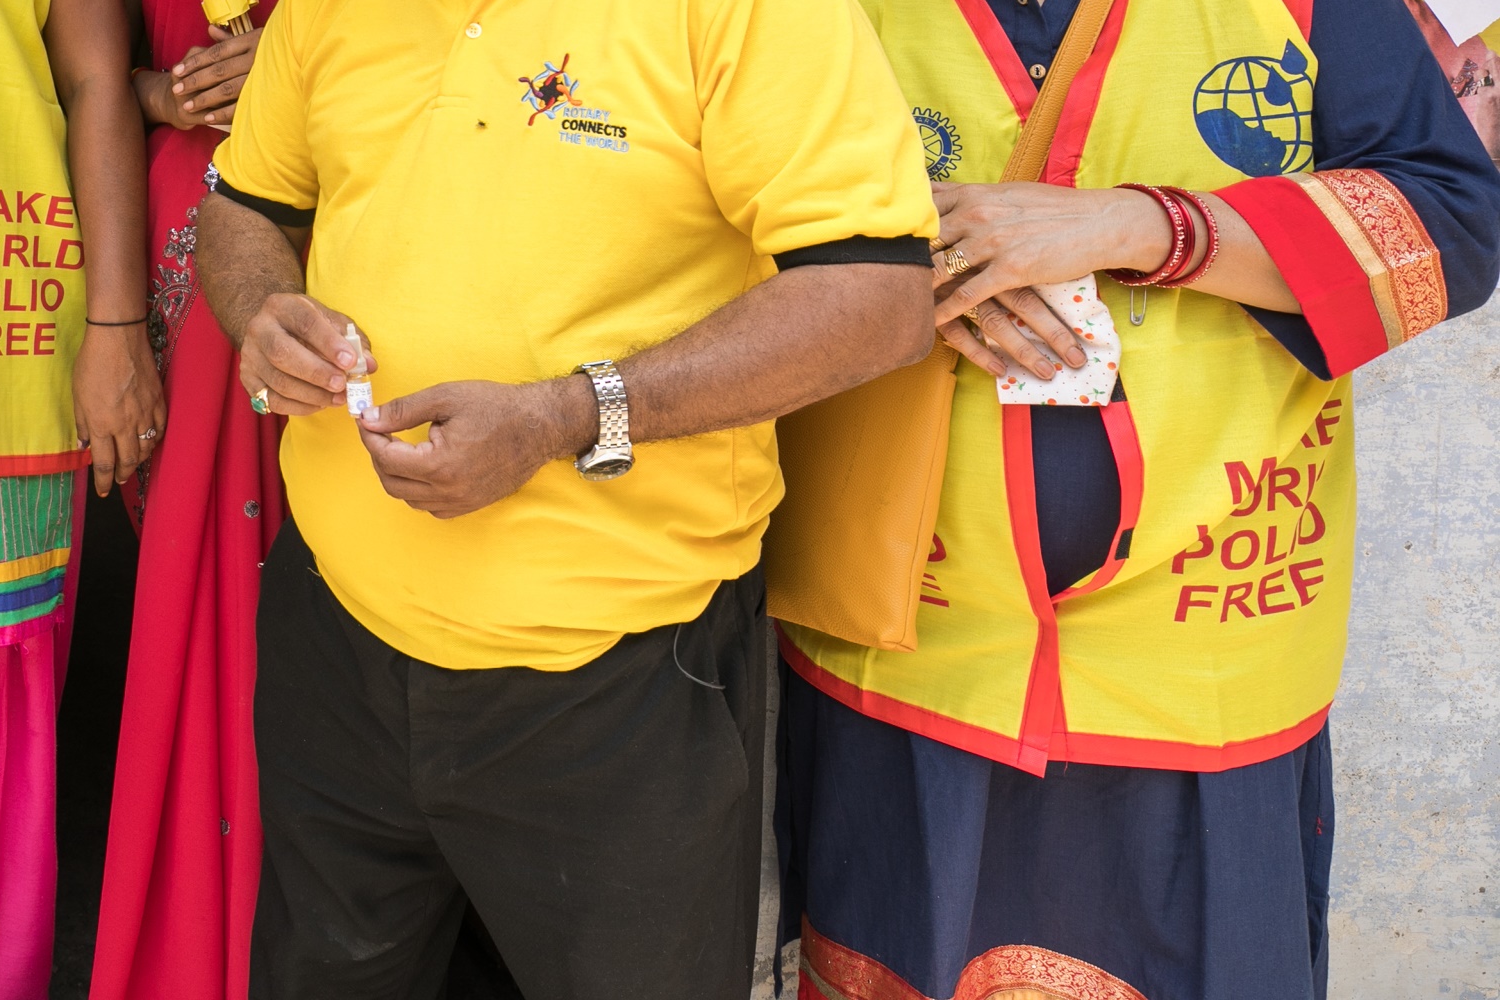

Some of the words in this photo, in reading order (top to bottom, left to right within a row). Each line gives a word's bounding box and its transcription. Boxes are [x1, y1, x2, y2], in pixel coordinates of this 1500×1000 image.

[562, 106, 611, 122] ROTARY
[561, 119, 628, 139] CONNECTS
[558, 131, 582, 145] THE
[585, 134, 630, 153] WORLD
[1173, 557, 1325, 624] FREE
